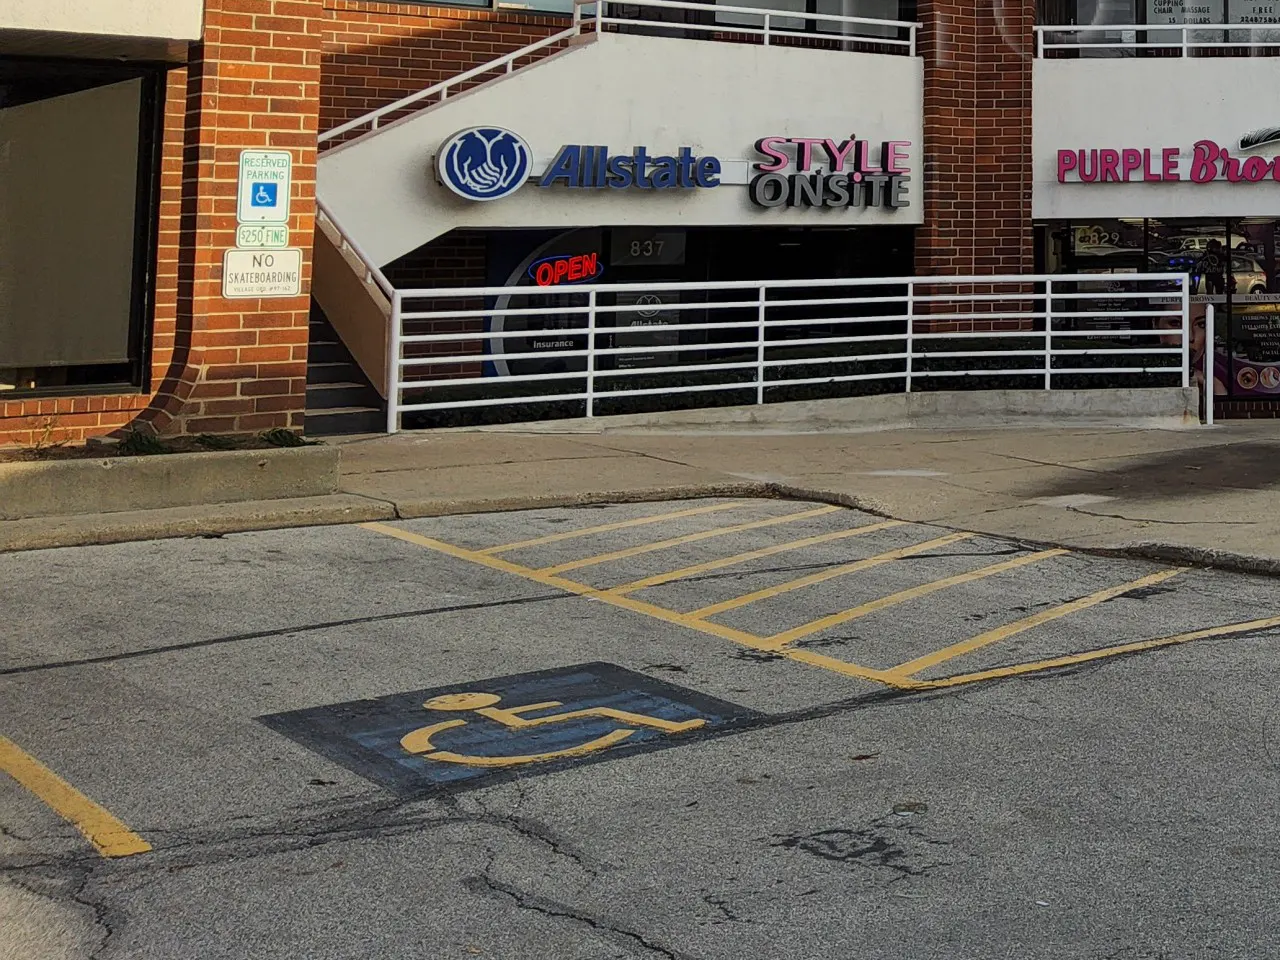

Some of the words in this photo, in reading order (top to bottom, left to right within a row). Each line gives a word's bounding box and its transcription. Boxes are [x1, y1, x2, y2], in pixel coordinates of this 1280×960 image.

[1153, 0, 1184, 7] CUPPING
[1153, 6, 1173, 14] CHAIR
[1252, 6, 1273, 14] FREE
[754, 136, 911, 174] STYLE
[244, 158, 287, 168] RESERVED
[538, 144, 722, 190] Allstate
[1057, 147, 1180, 184] PURPLE
[246, 170, 284, 180] PARKING
[241, 230, 263, 243] $250
[266, 230, 284, 243] FINE
[1090, 232, 1120, 245] 829
[630, 240, 665, 257] 837
[252, 254, 274, 268] NO
[535, 252, 597, 287] OPEN
[228, 271, 297, 284] SKATEBOARDING
[533, 340, 574, 349] Insurance
